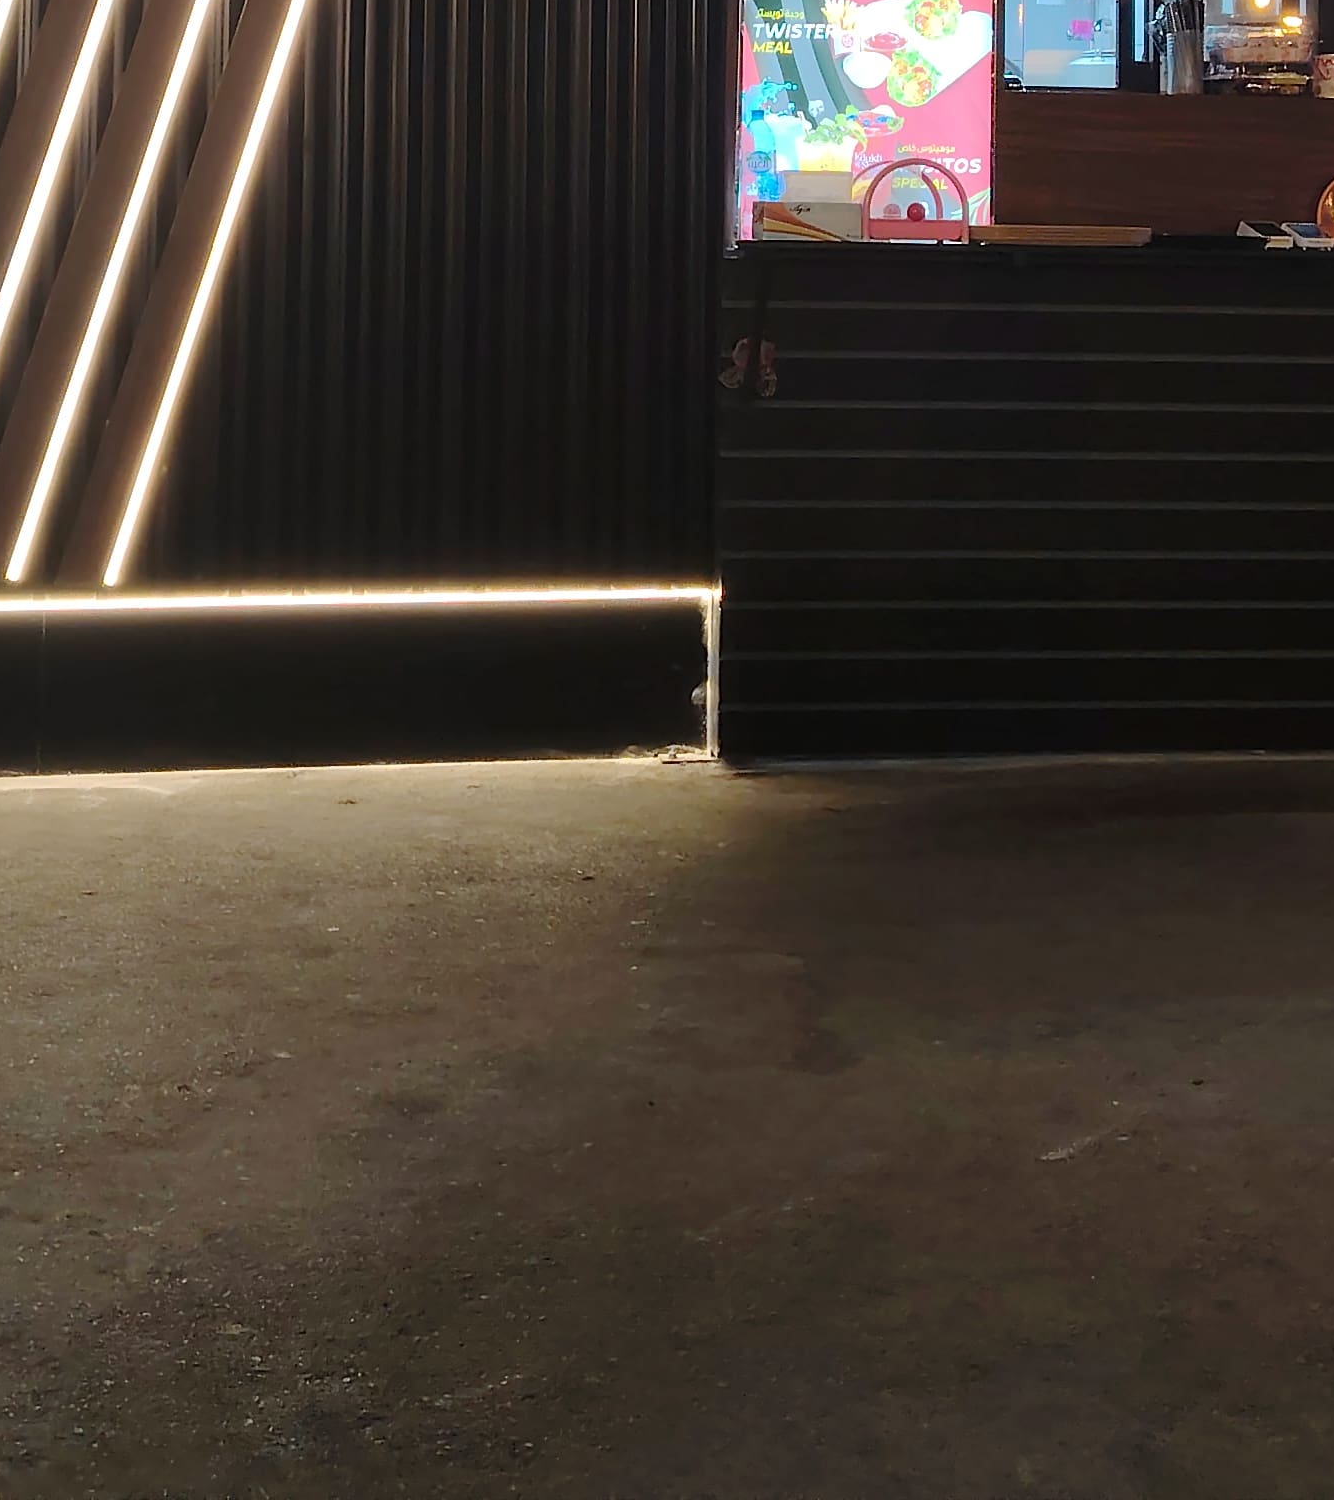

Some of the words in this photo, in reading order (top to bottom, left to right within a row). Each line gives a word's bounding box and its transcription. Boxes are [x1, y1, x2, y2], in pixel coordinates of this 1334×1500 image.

[752, 22, 835, 40] TWISTER
[752, 40, 793, 55] MEAL
[891, 176, 948, 190] SPECAL
